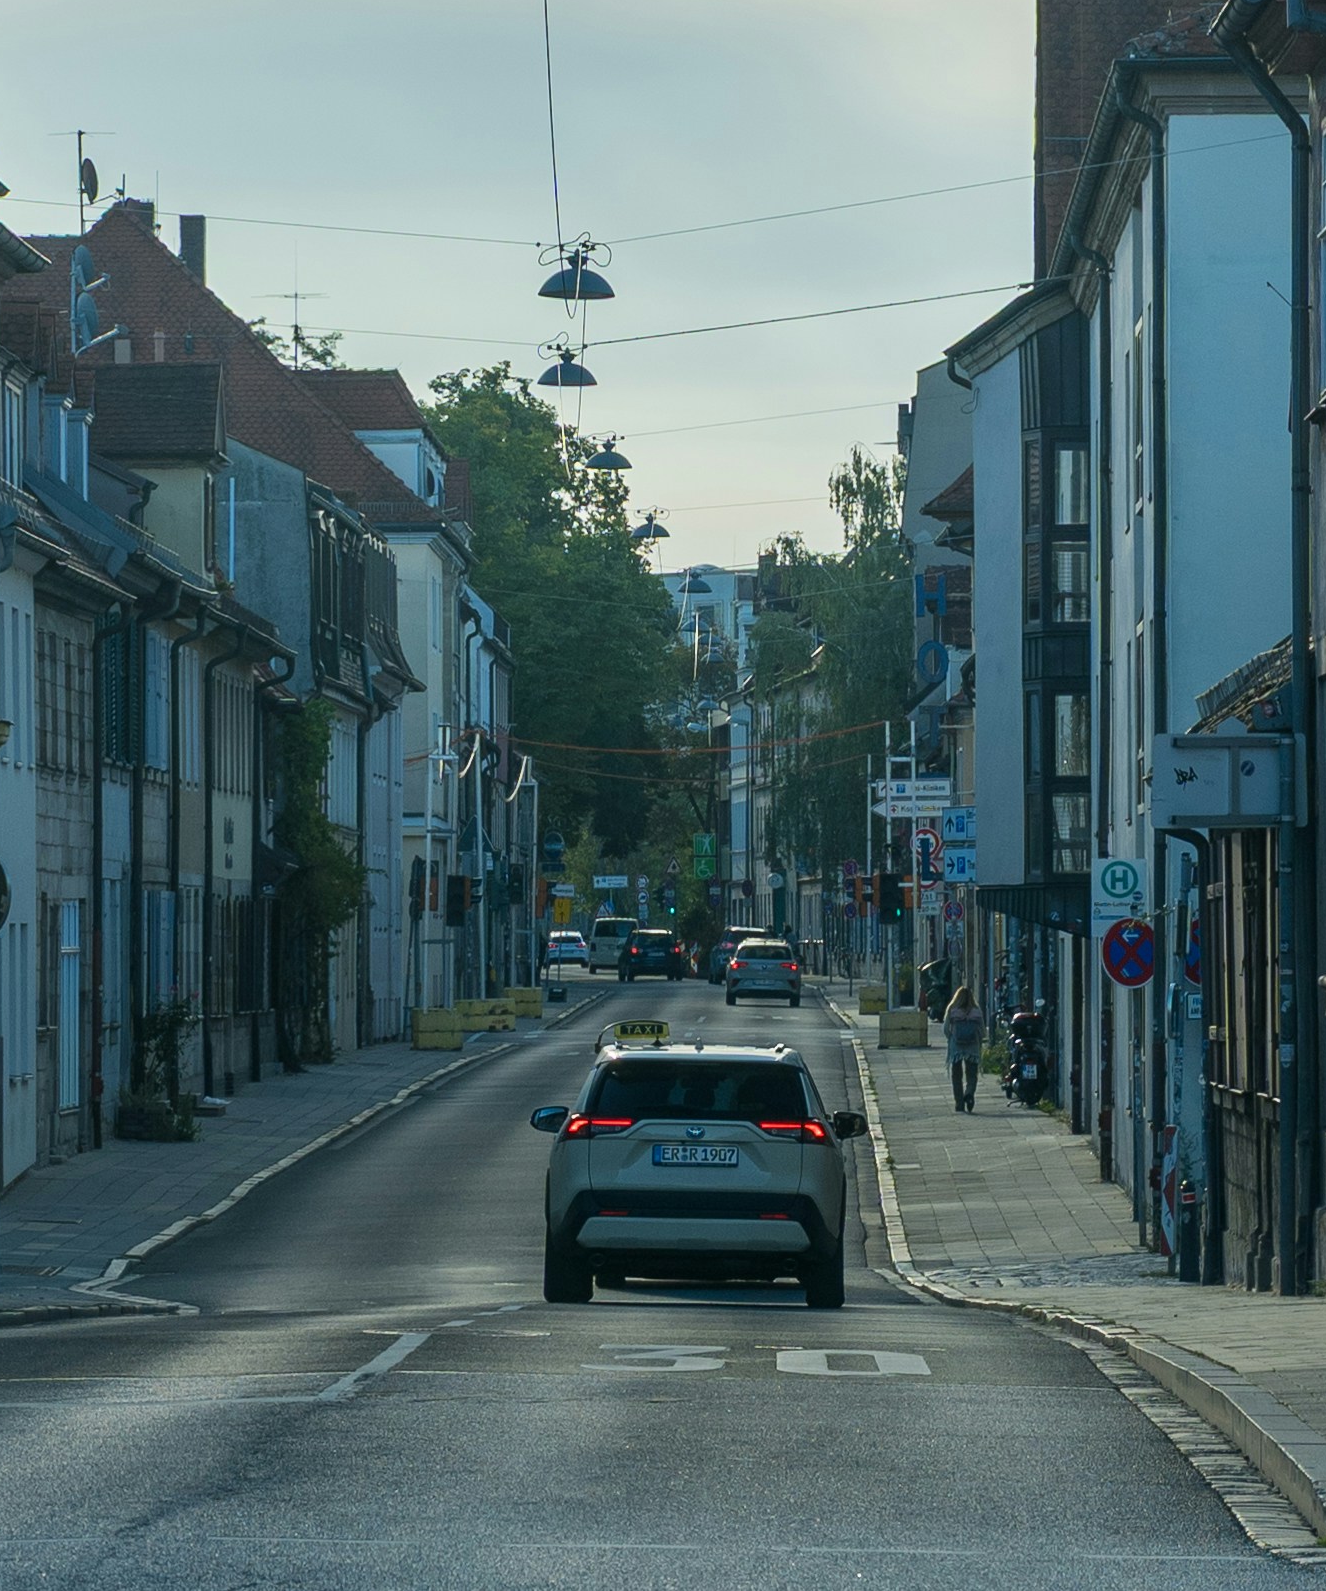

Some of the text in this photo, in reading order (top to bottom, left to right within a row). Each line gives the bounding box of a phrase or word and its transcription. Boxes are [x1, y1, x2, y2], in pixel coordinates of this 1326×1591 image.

[624, 1024, 660, 1035] TAXI
[662, 1147, 680, 1161] ER
[701, 1148, 735, 1162] 1907
